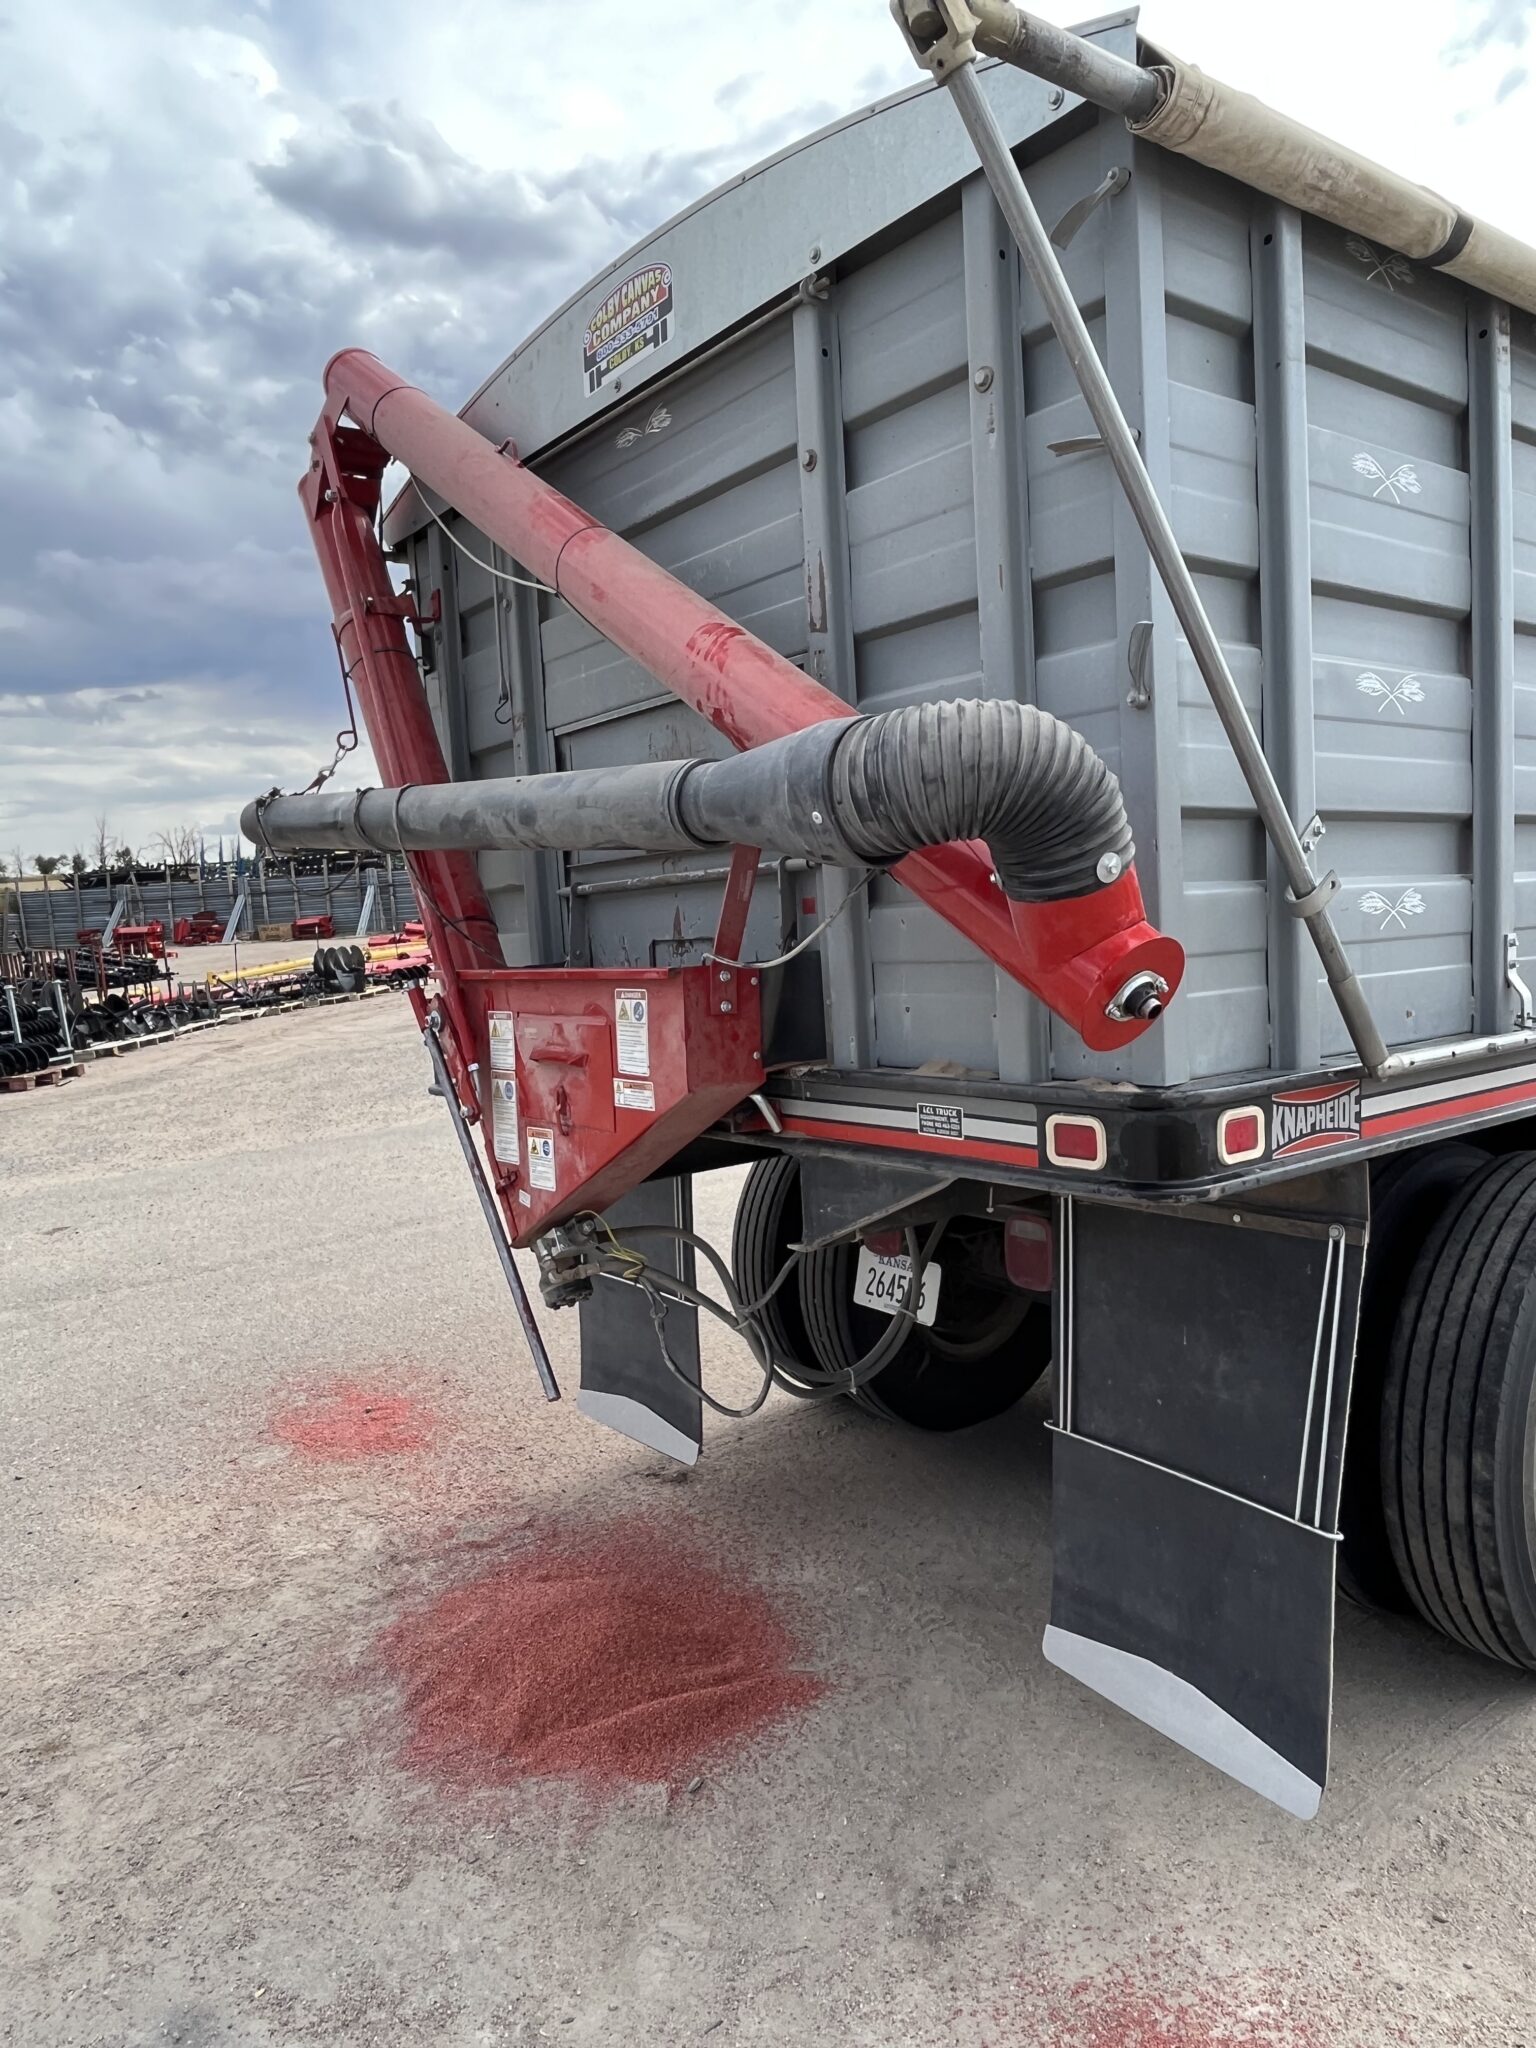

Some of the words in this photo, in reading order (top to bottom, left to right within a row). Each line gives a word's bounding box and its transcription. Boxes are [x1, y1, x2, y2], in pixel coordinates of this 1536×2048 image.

[591, 289, 620, 331] COLBY
[621, 269, 661, 307] CANVAS
[592, 284, 660, 346] COMPANY
[634, 337, 645, 352] KS
[923, 1106, 934, 1114] LCL
[936, 1108, 957, 1117] TRUCK
[1272, 1088, 1360, 1150] KNAPHEIDE
[879, 1255, 912, 1272] KANSA
[866, 1267, 925, 1310] 26456
